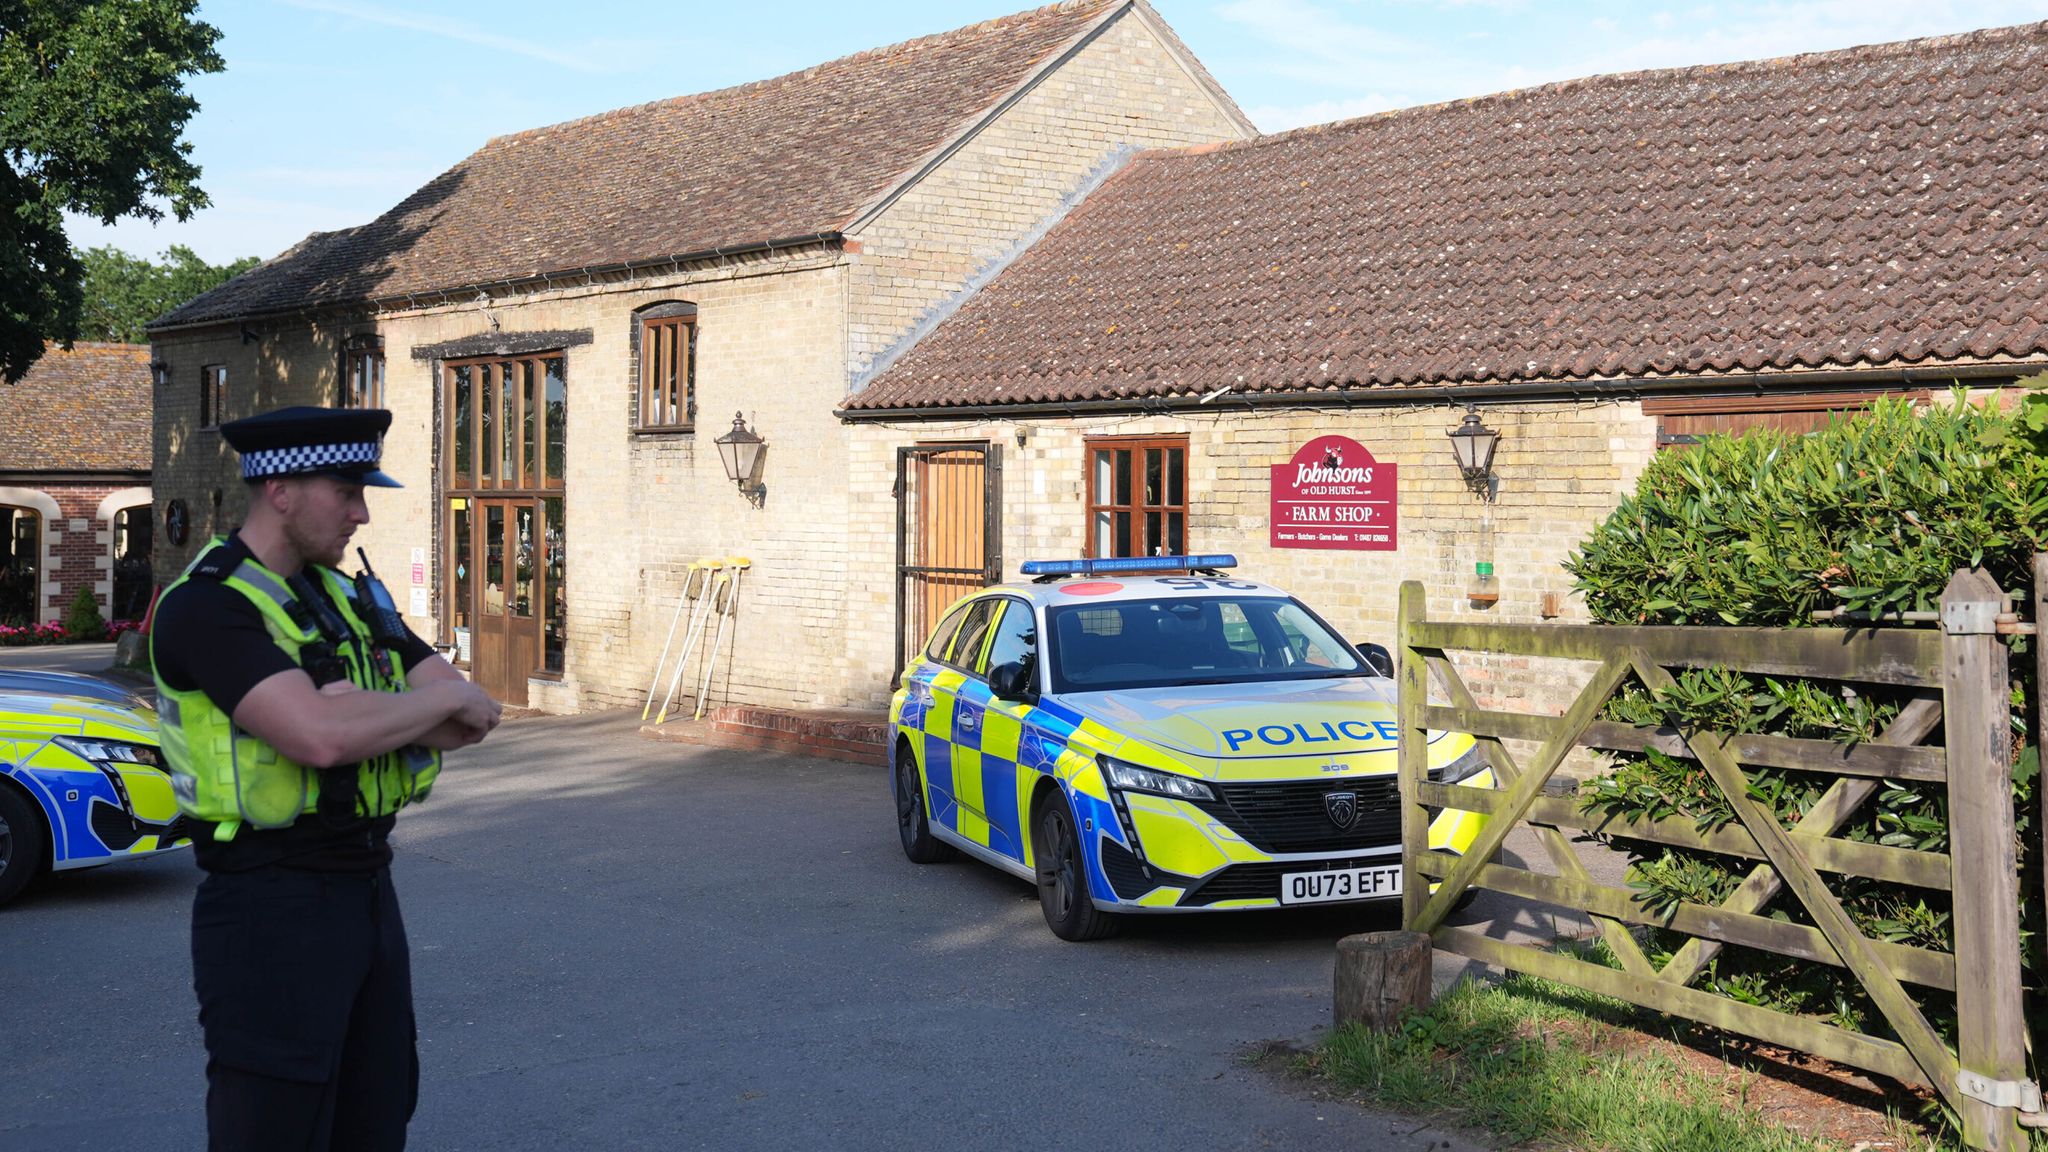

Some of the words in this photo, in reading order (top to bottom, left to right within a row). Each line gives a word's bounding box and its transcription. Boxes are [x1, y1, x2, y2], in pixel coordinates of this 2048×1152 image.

[1292, 462, 1373, 488] Johnsons
[1310, 486, 1327, 495] OLD
[1328, 486, 1356, 495] HURST
[1292, 506, 1331, 521] FARM
[1335, 507, 1373, 522] SHOP
[1222, 721, 1398, 751] POLICE
[1292, 873, 1351, 899] OU73
[1358, 869, 1400, 894] EFT
